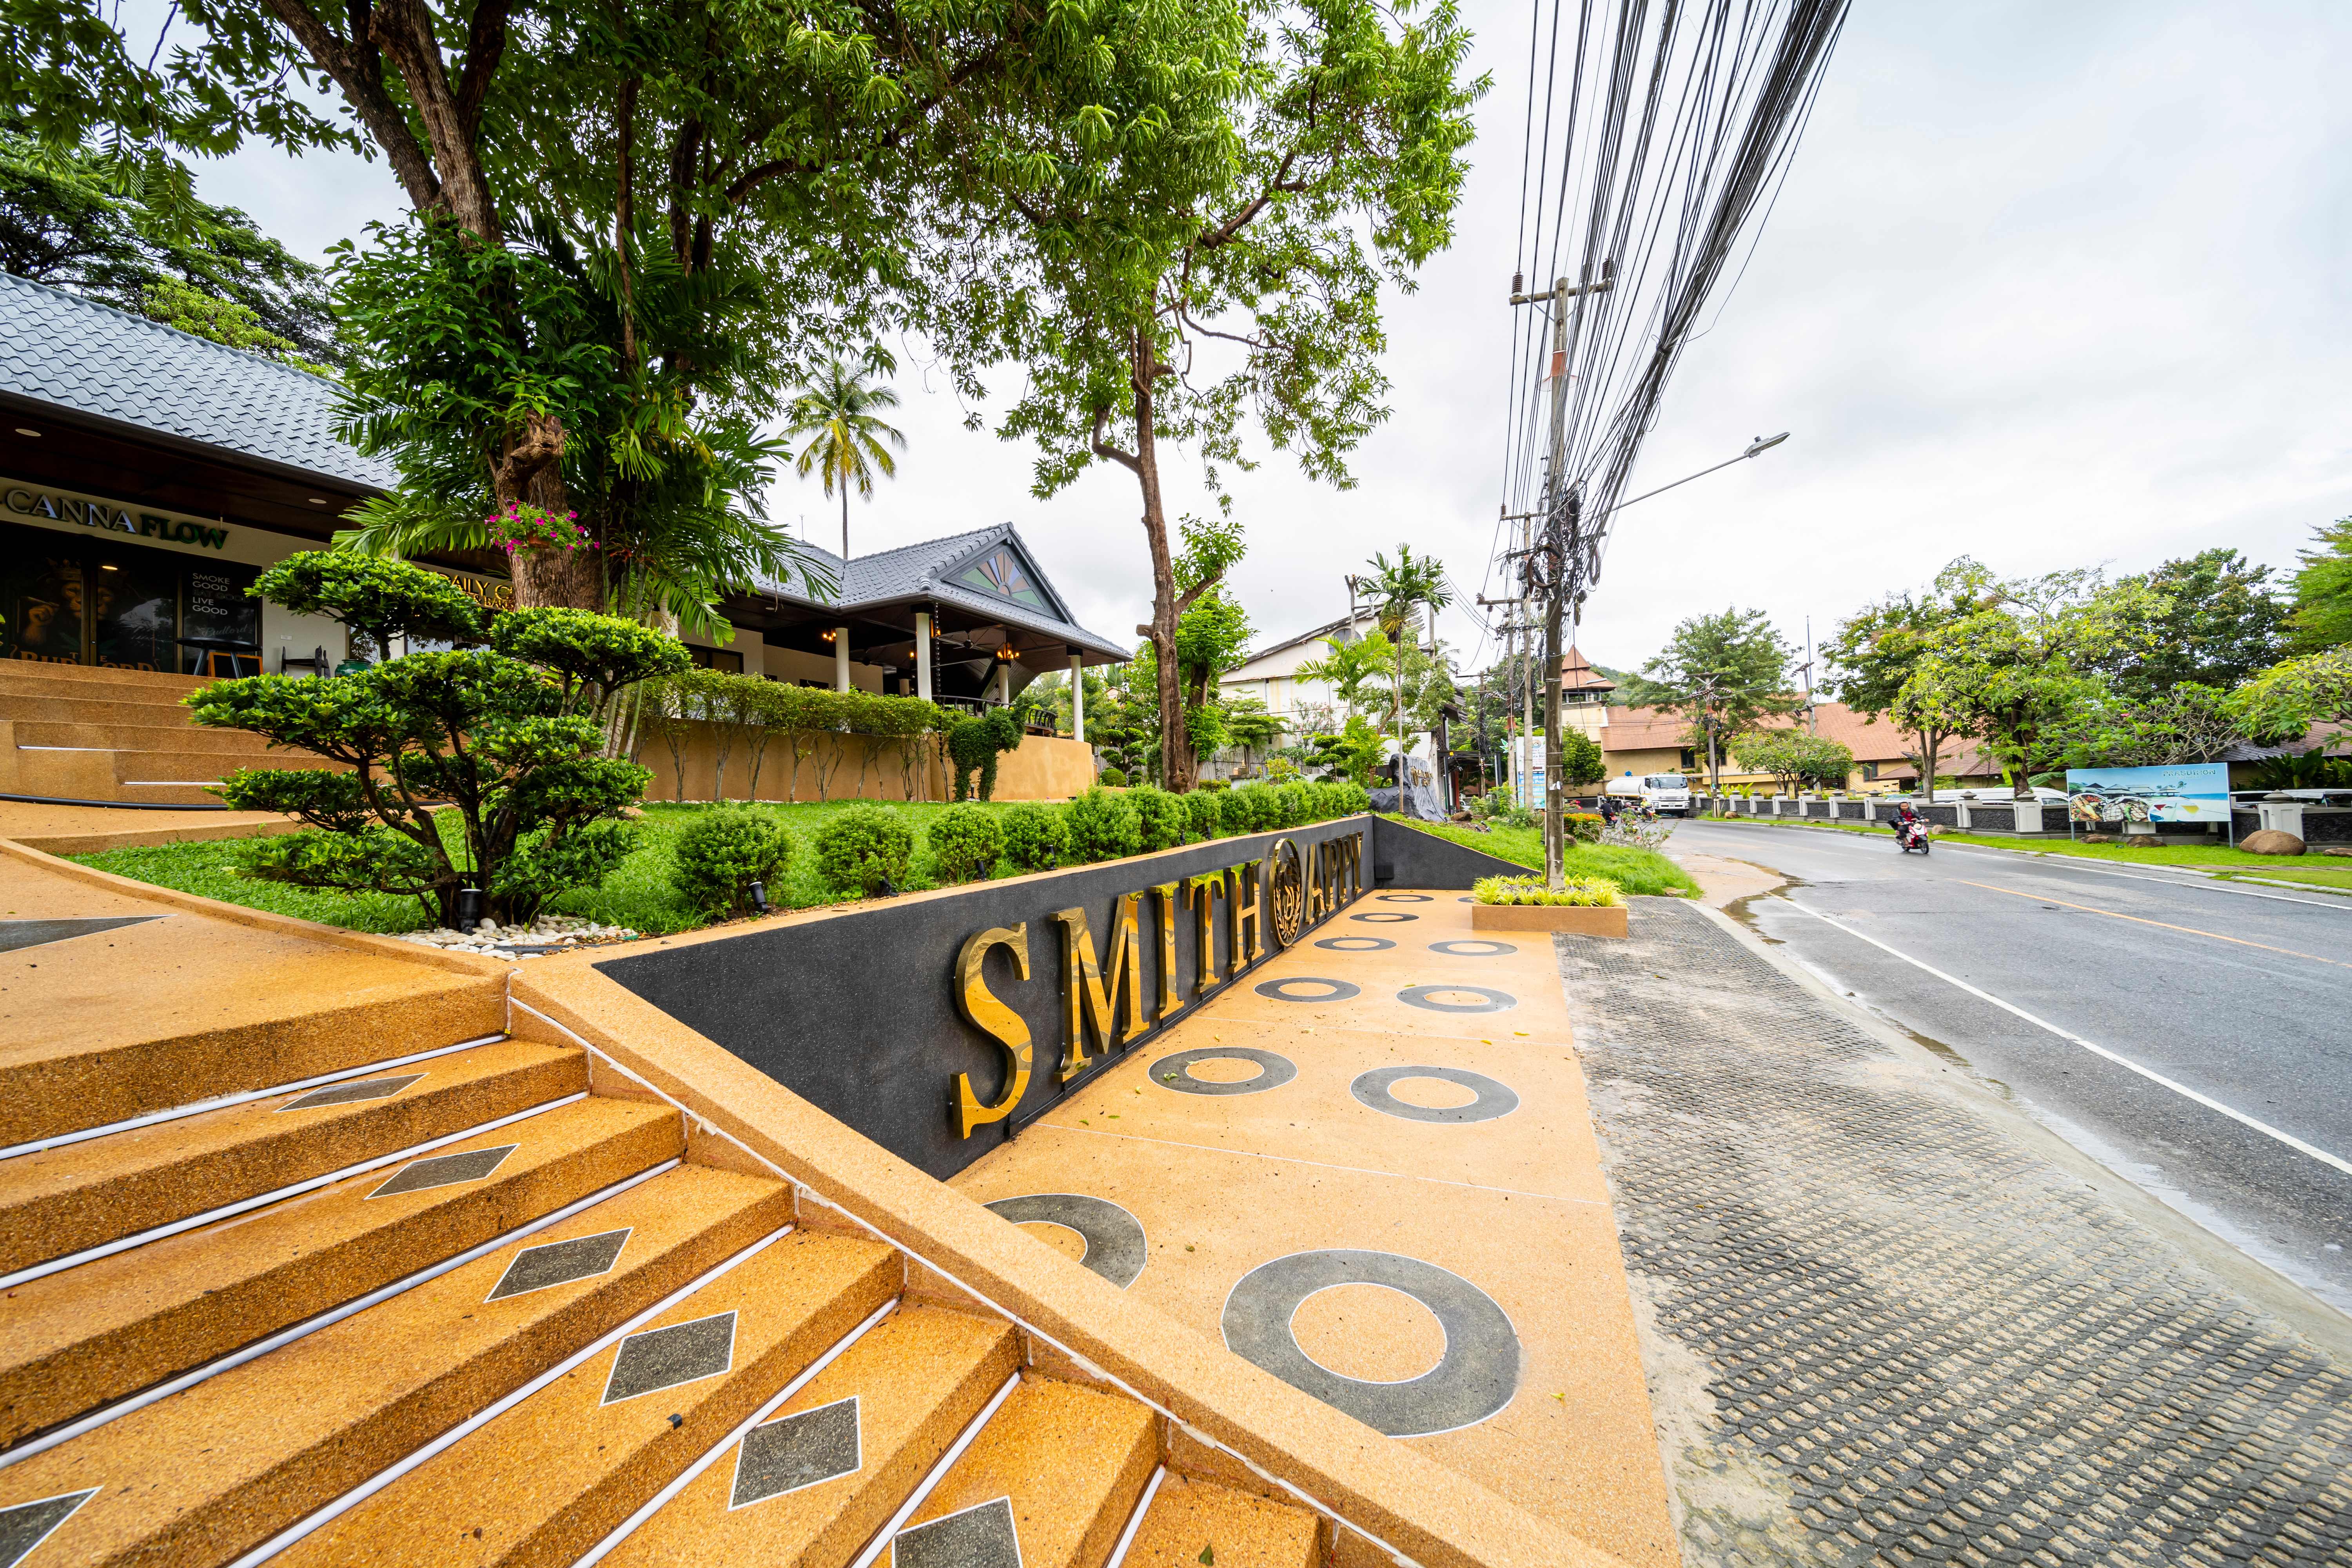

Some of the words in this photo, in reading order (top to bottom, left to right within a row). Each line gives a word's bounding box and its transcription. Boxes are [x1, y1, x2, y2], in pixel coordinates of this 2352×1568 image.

[5, 489, 137, 534] CANNA
[139, 514, 229, 550] FLOW
[192, 572, 230, 584] SMOKE
[192, 581, 228, 592] GOOD
[192, 596, 214, 606] LIVE
[192, 605, 228, 615] GOOD
[950, 858, 1265, 1140] SMITH
[1304, 831, 1364, 926] APPY
